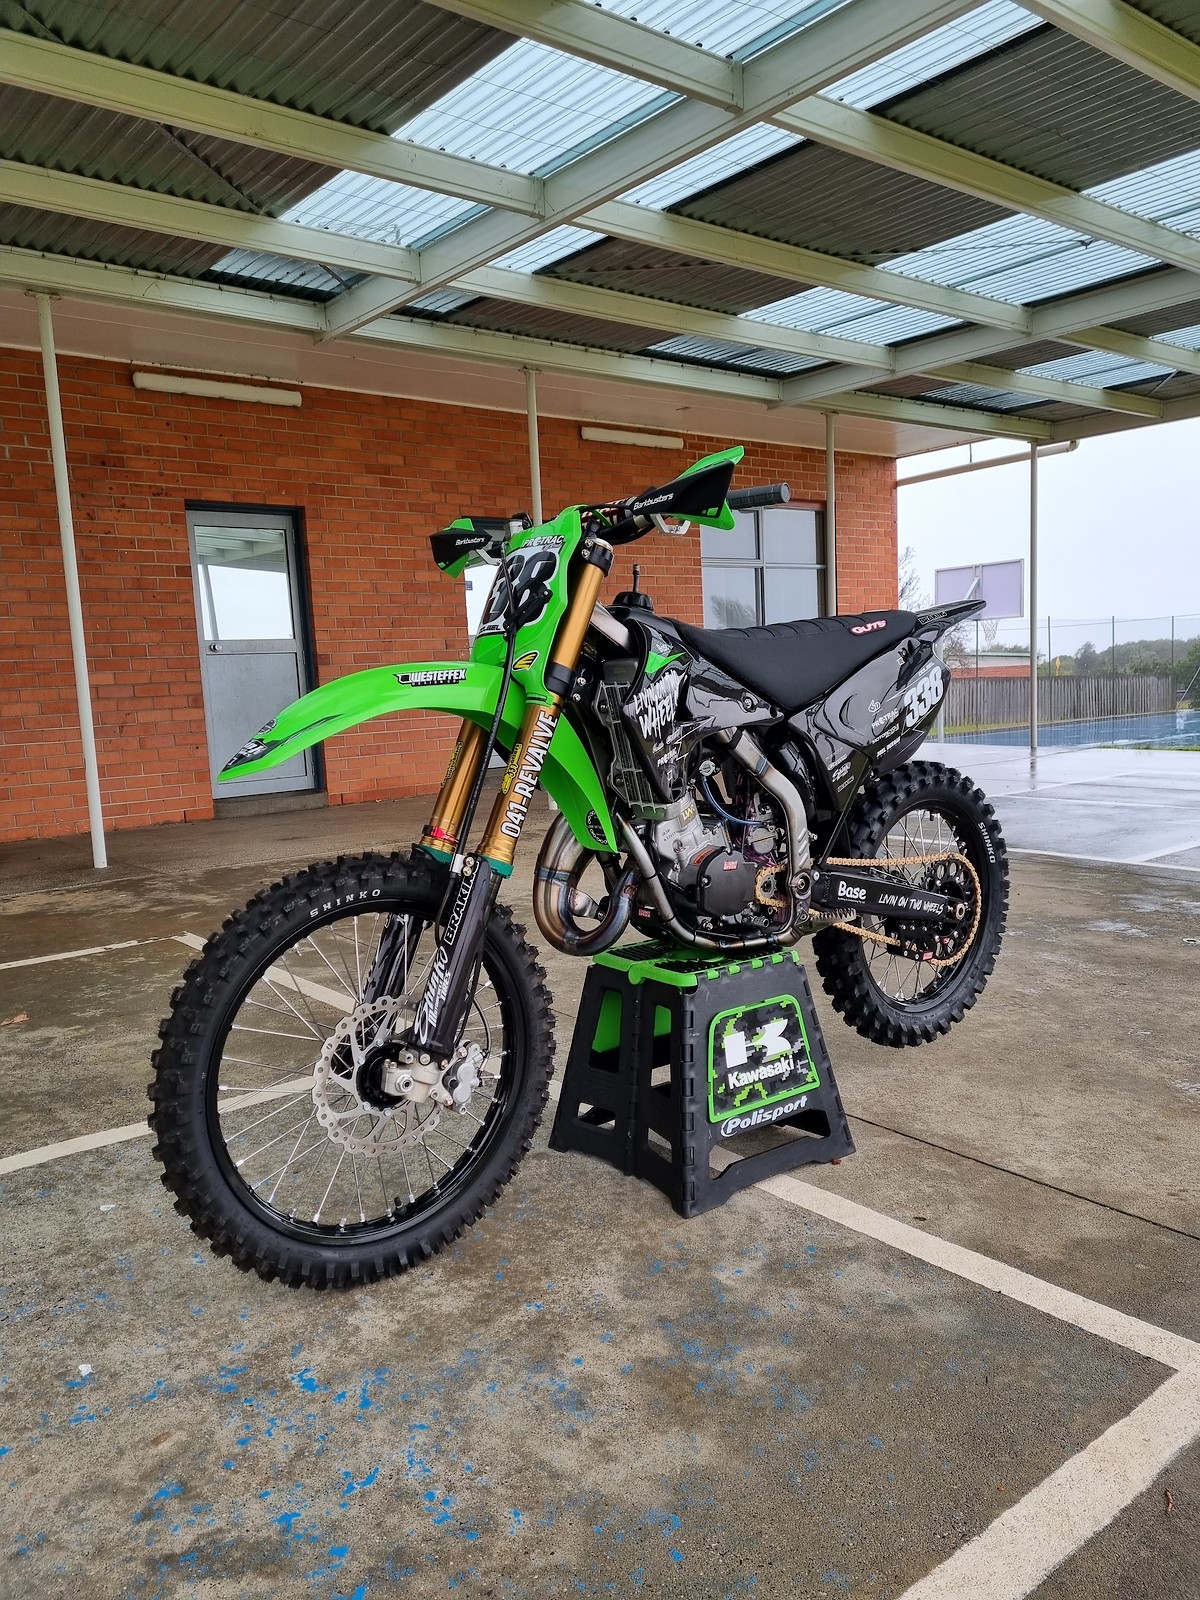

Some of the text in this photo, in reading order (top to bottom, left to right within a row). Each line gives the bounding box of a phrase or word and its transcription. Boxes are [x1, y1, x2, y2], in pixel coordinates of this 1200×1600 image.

[633, 493, 674, 511] Barkbusters
[455, 537, 486, 546] Barkbusters
[852, 620, 886, 634] GUTS
[904, 666, 944, 728] 338
[978, 822, 996, 864] SHINKO
[838, 881, 867, 900] Base
[310, 888, 381, 918] SHINKO
[897, 896, 909, 908] ON
[922, 901, 945, 915] WHEELS
[728, 1055, 795, 1090] Kawasaki
[721, 1096, 808, 1137] Polisport
